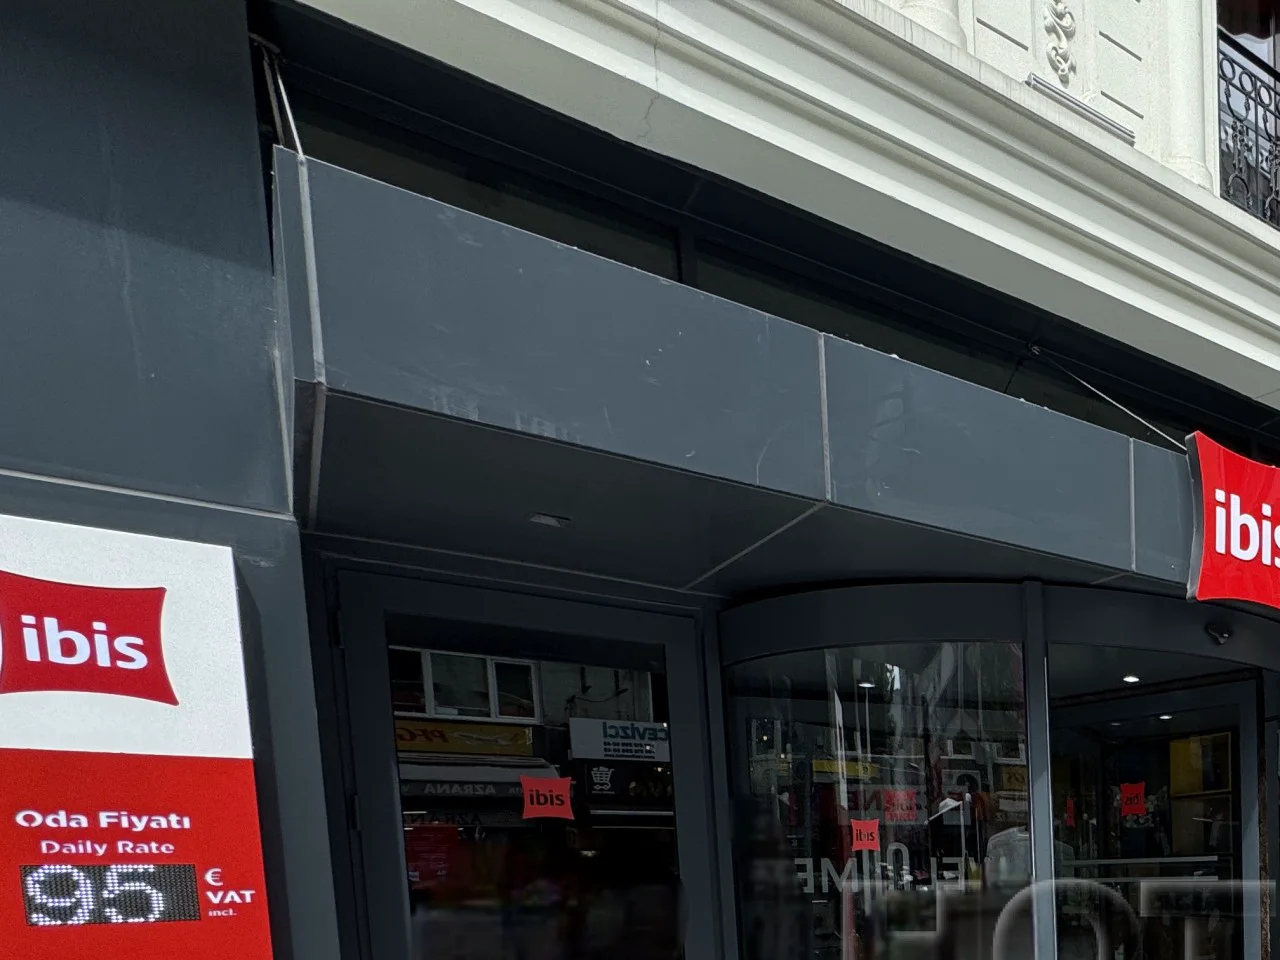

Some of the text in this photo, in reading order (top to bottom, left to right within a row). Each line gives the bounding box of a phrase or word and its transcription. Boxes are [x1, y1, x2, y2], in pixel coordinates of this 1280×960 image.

[20, 614, 148, 670] ibis
[528, 788, 565, 807] ibis
[15, 810, 191, 832] Oda Fiyatı
[40, 840, 175, 856] Daily Rate
[204, 867, 223, 886] €
[26, 864, 165, 925] 95
[206, 890, 256, 904] VAT
[208, 907, 237, 917] incl.
